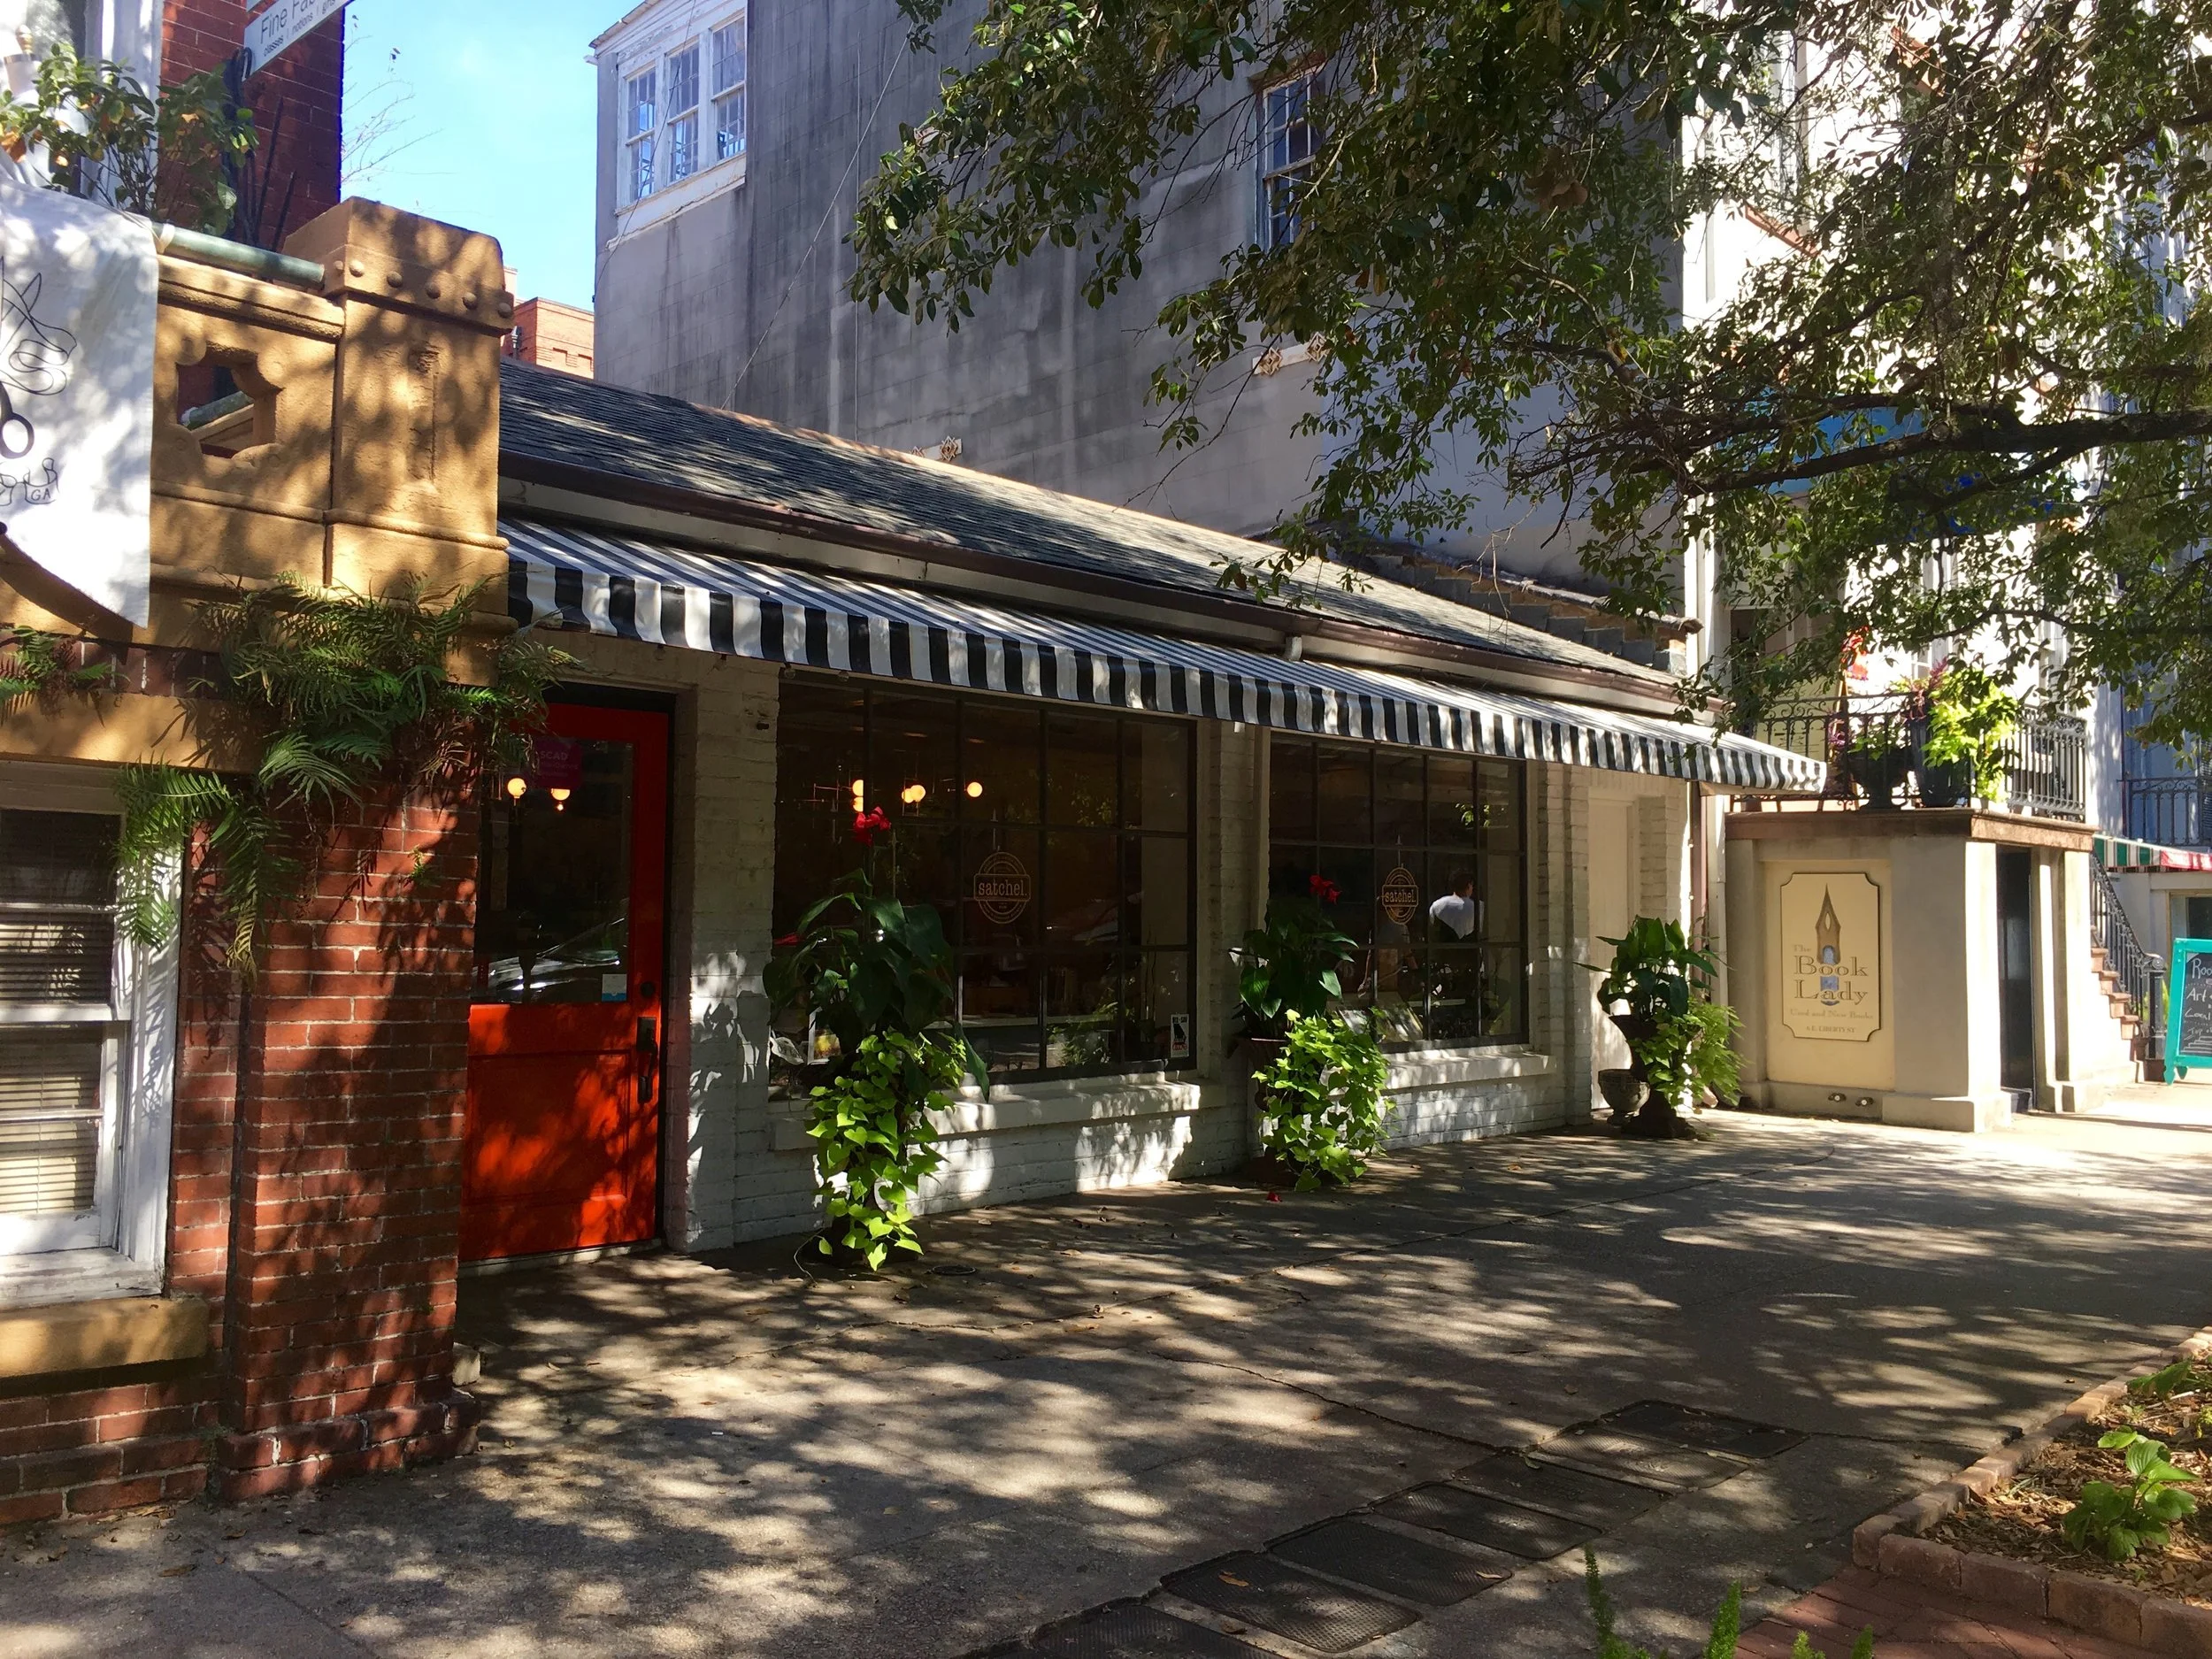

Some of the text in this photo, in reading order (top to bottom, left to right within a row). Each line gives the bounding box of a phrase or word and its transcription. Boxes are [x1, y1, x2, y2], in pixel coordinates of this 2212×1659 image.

[260, 8, 288, 44] Fine
[292, 12, 313, 35] notions
[31, 488, 50, 502] GA
[978, 879, 1027, 896] satchel.
[1793, 955, 1869, 977] Book
[1794, 979, 1868, 1005] Lady
[2185, 987, 2207, 1002] Art
